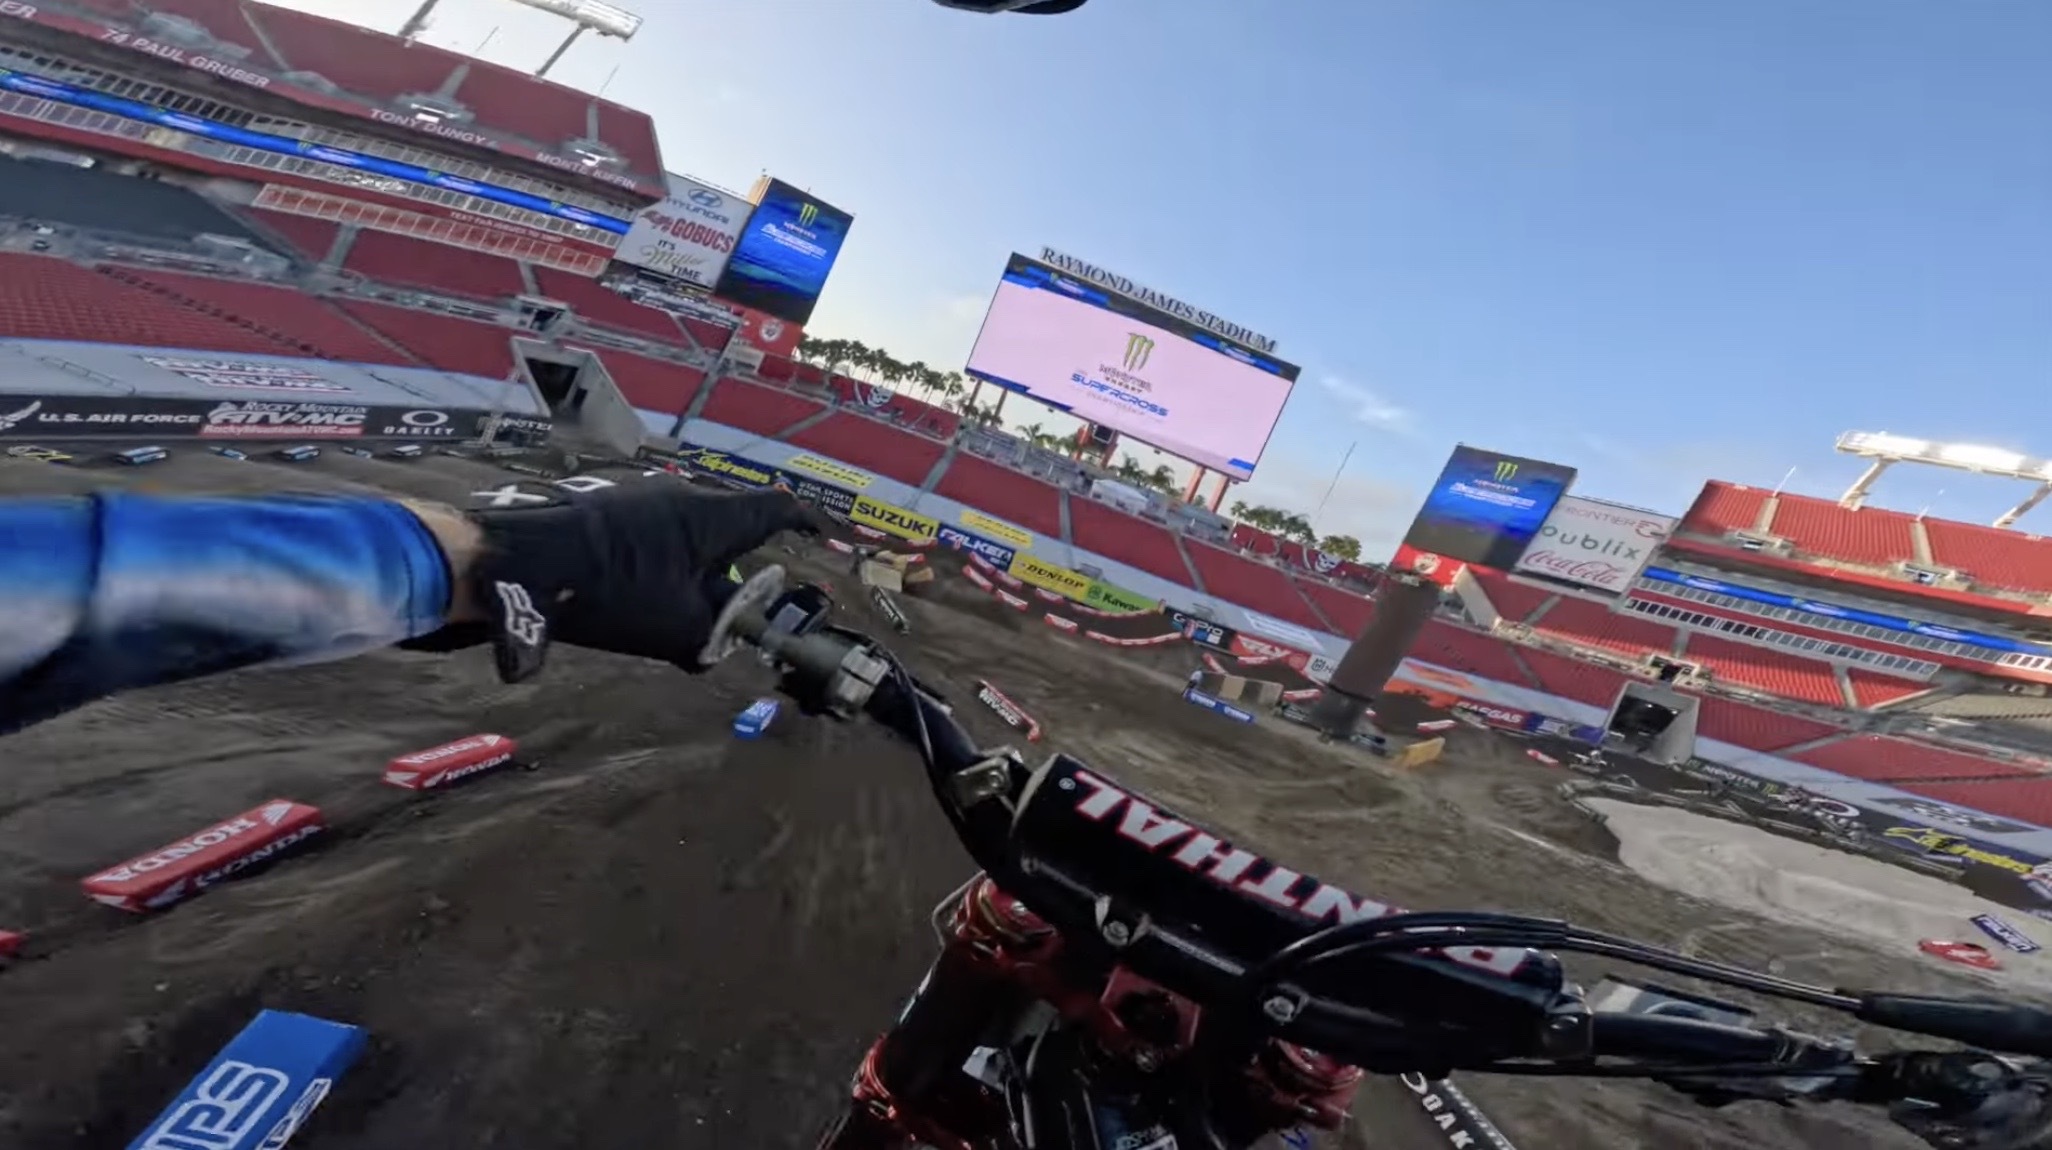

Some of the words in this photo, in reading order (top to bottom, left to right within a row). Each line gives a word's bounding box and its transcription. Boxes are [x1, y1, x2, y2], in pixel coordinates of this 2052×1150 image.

[101, 29, 129, 45] 74
[132, 33, 185, 64] PAUL
[190, 52, 270, 88] GRUBER
[370, 108, 417, 132] TONY
[421, 122, 487, 146] DUNGY
[670, 218, 734, 254] GOBUCS
[671, 264, 702, 280] TIME
[1040, 246, 1134, 297] RAYMOND
[1132, 285, 1196, 322] JAMES
[1197, 310, 1277, 352] STADIUM
[1071, 373, 1169, 416] SUPERCROSS
[38, 413, 84, 423] U.S.
[86, 413, 127, 423] AIR
[130, 414, 201, 424] FORCE
[383, 426, 455, 436] OAKLEY
[796, 488, 851, 509] COMISSION
[854, 501, 934, 537] SUZUKI
[1026, 563, 1085, 589] DUNLOP
[1173, 612, 1223, 636] GPro
[91, 818, 258, 882] HONDA
[195, 825, 322, 887] HONDA
[1073, 769, 1528, 976] RNTHAL
[137, 1060, 289, 1150] PS
